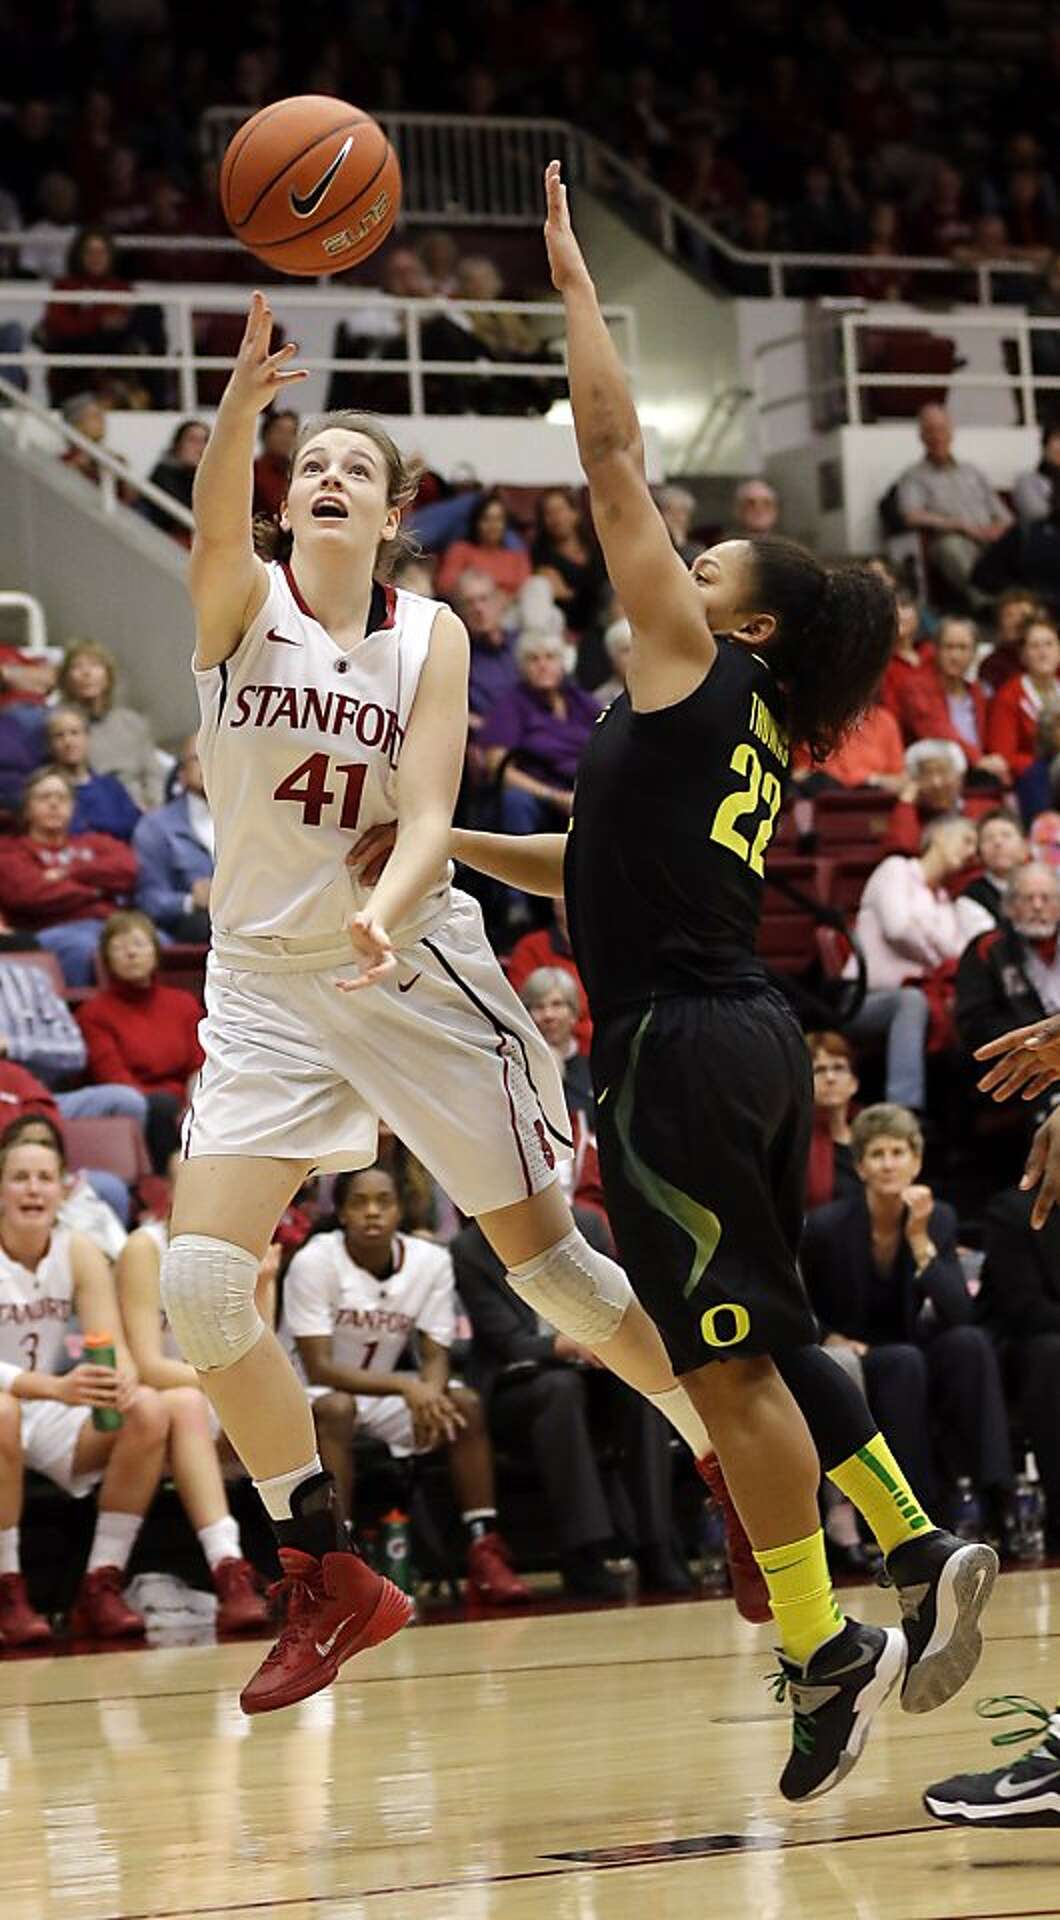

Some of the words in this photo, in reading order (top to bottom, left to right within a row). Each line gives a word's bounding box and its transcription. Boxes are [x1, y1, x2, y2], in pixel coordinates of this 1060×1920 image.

[229, 685, 406, 770] STANFOR
[273, 751, 369, 830] 41
[709, 743, 781, 880] 22
[360, 1341, 379, 1371] 1
[700, 1303, 751, 1348] O
